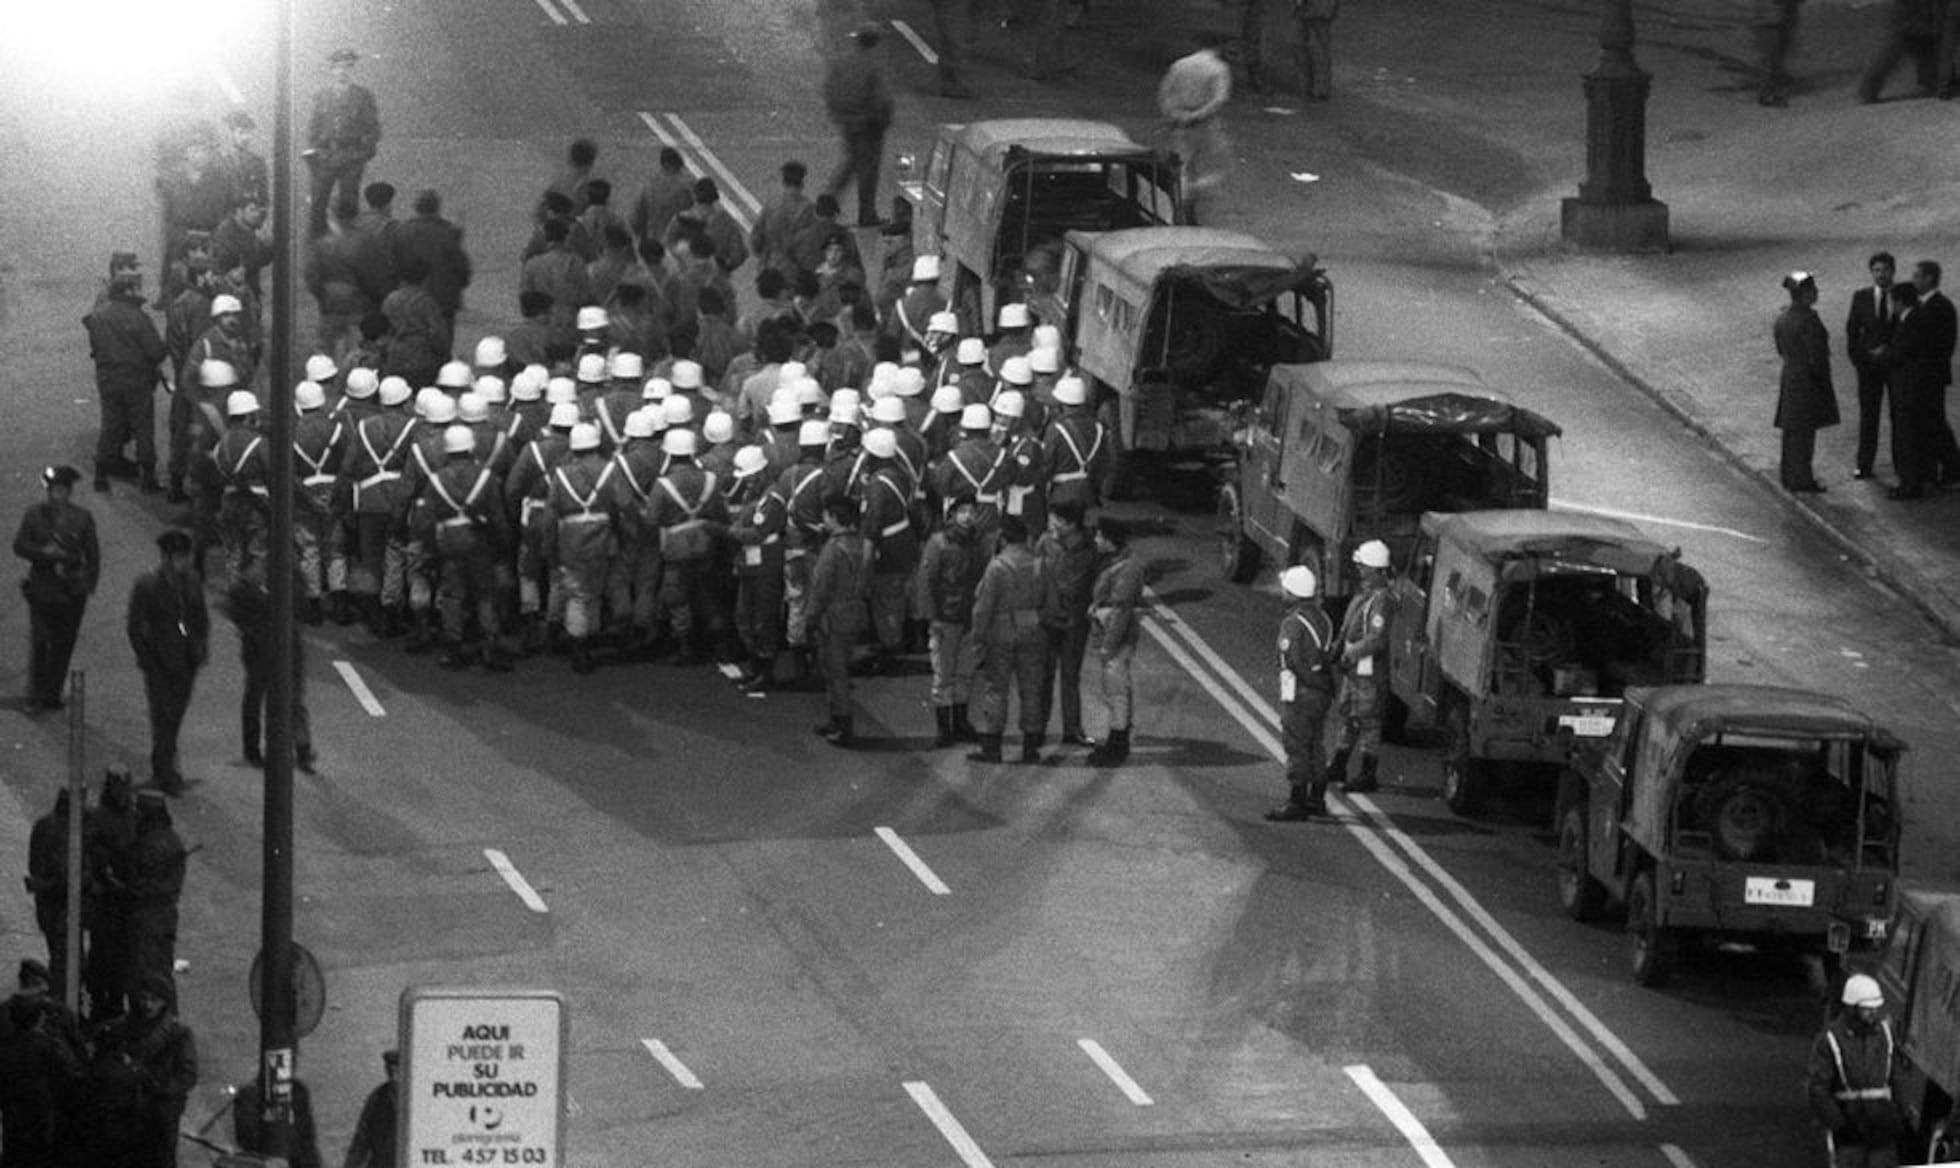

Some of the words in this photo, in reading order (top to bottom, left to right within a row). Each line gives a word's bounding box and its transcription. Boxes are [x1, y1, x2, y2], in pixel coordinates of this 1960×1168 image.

[462, 1024, 510, 1041] AQUI
[447, 1044, 502, 1060] PUEDE
[509, 1044, 525, 1060] IR
[473, 1063, 499, 1079] SU
[433, 1082, 538, 1098] PUBLICIDAD
[462, 1148, 497, 1164] 457
[503, 1148, 519, 1164] 15
[522, 1147, 546, 1164] 03
